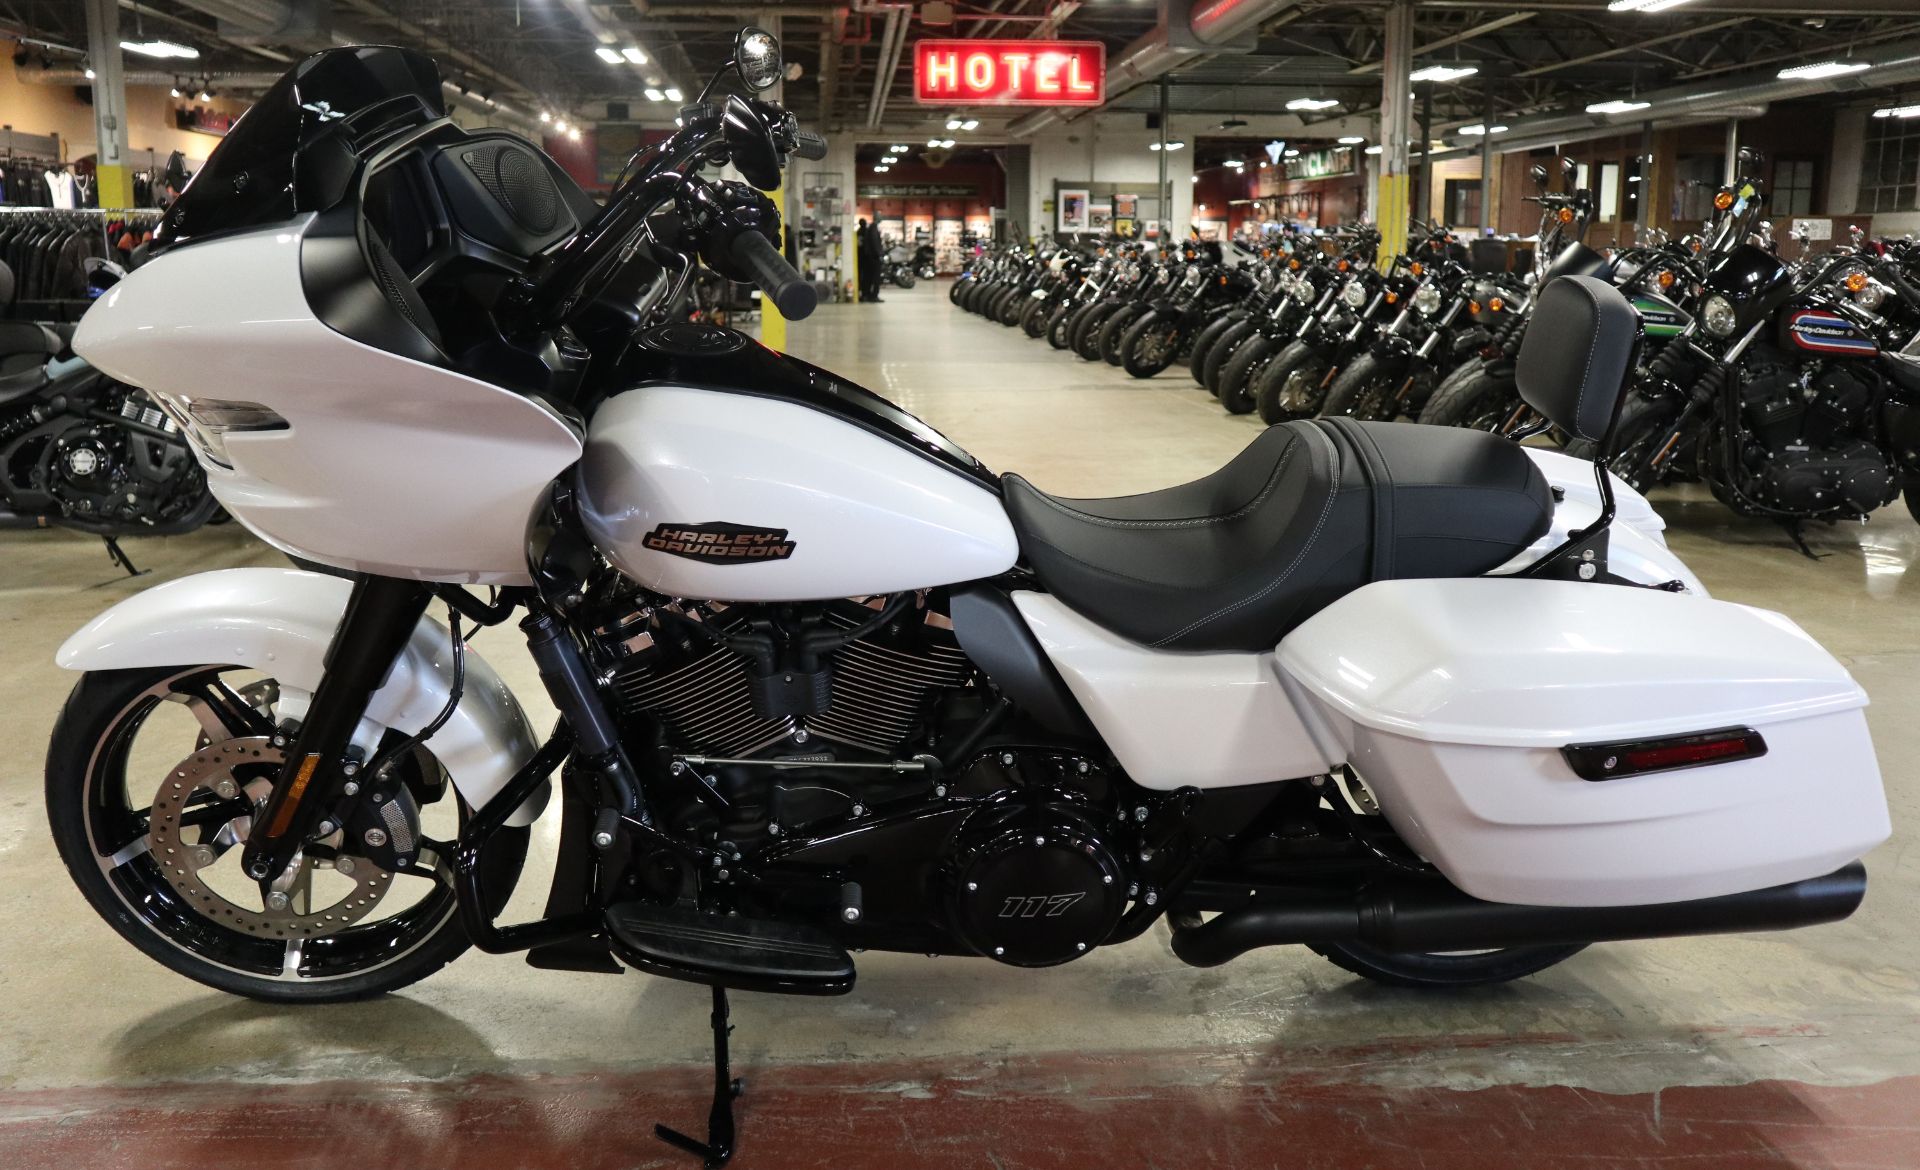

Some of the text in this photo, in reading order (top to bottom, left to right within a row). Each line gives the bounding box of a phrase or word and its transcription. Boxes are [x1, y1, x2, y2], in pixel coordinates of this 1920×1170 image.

[926, 51, 1094, 92] HOTEL
[648, 537, 788, 556] DAVIDSON
[660, 528, 781, 545] HARLEY-
[998, 891, 1086, 917] 117
